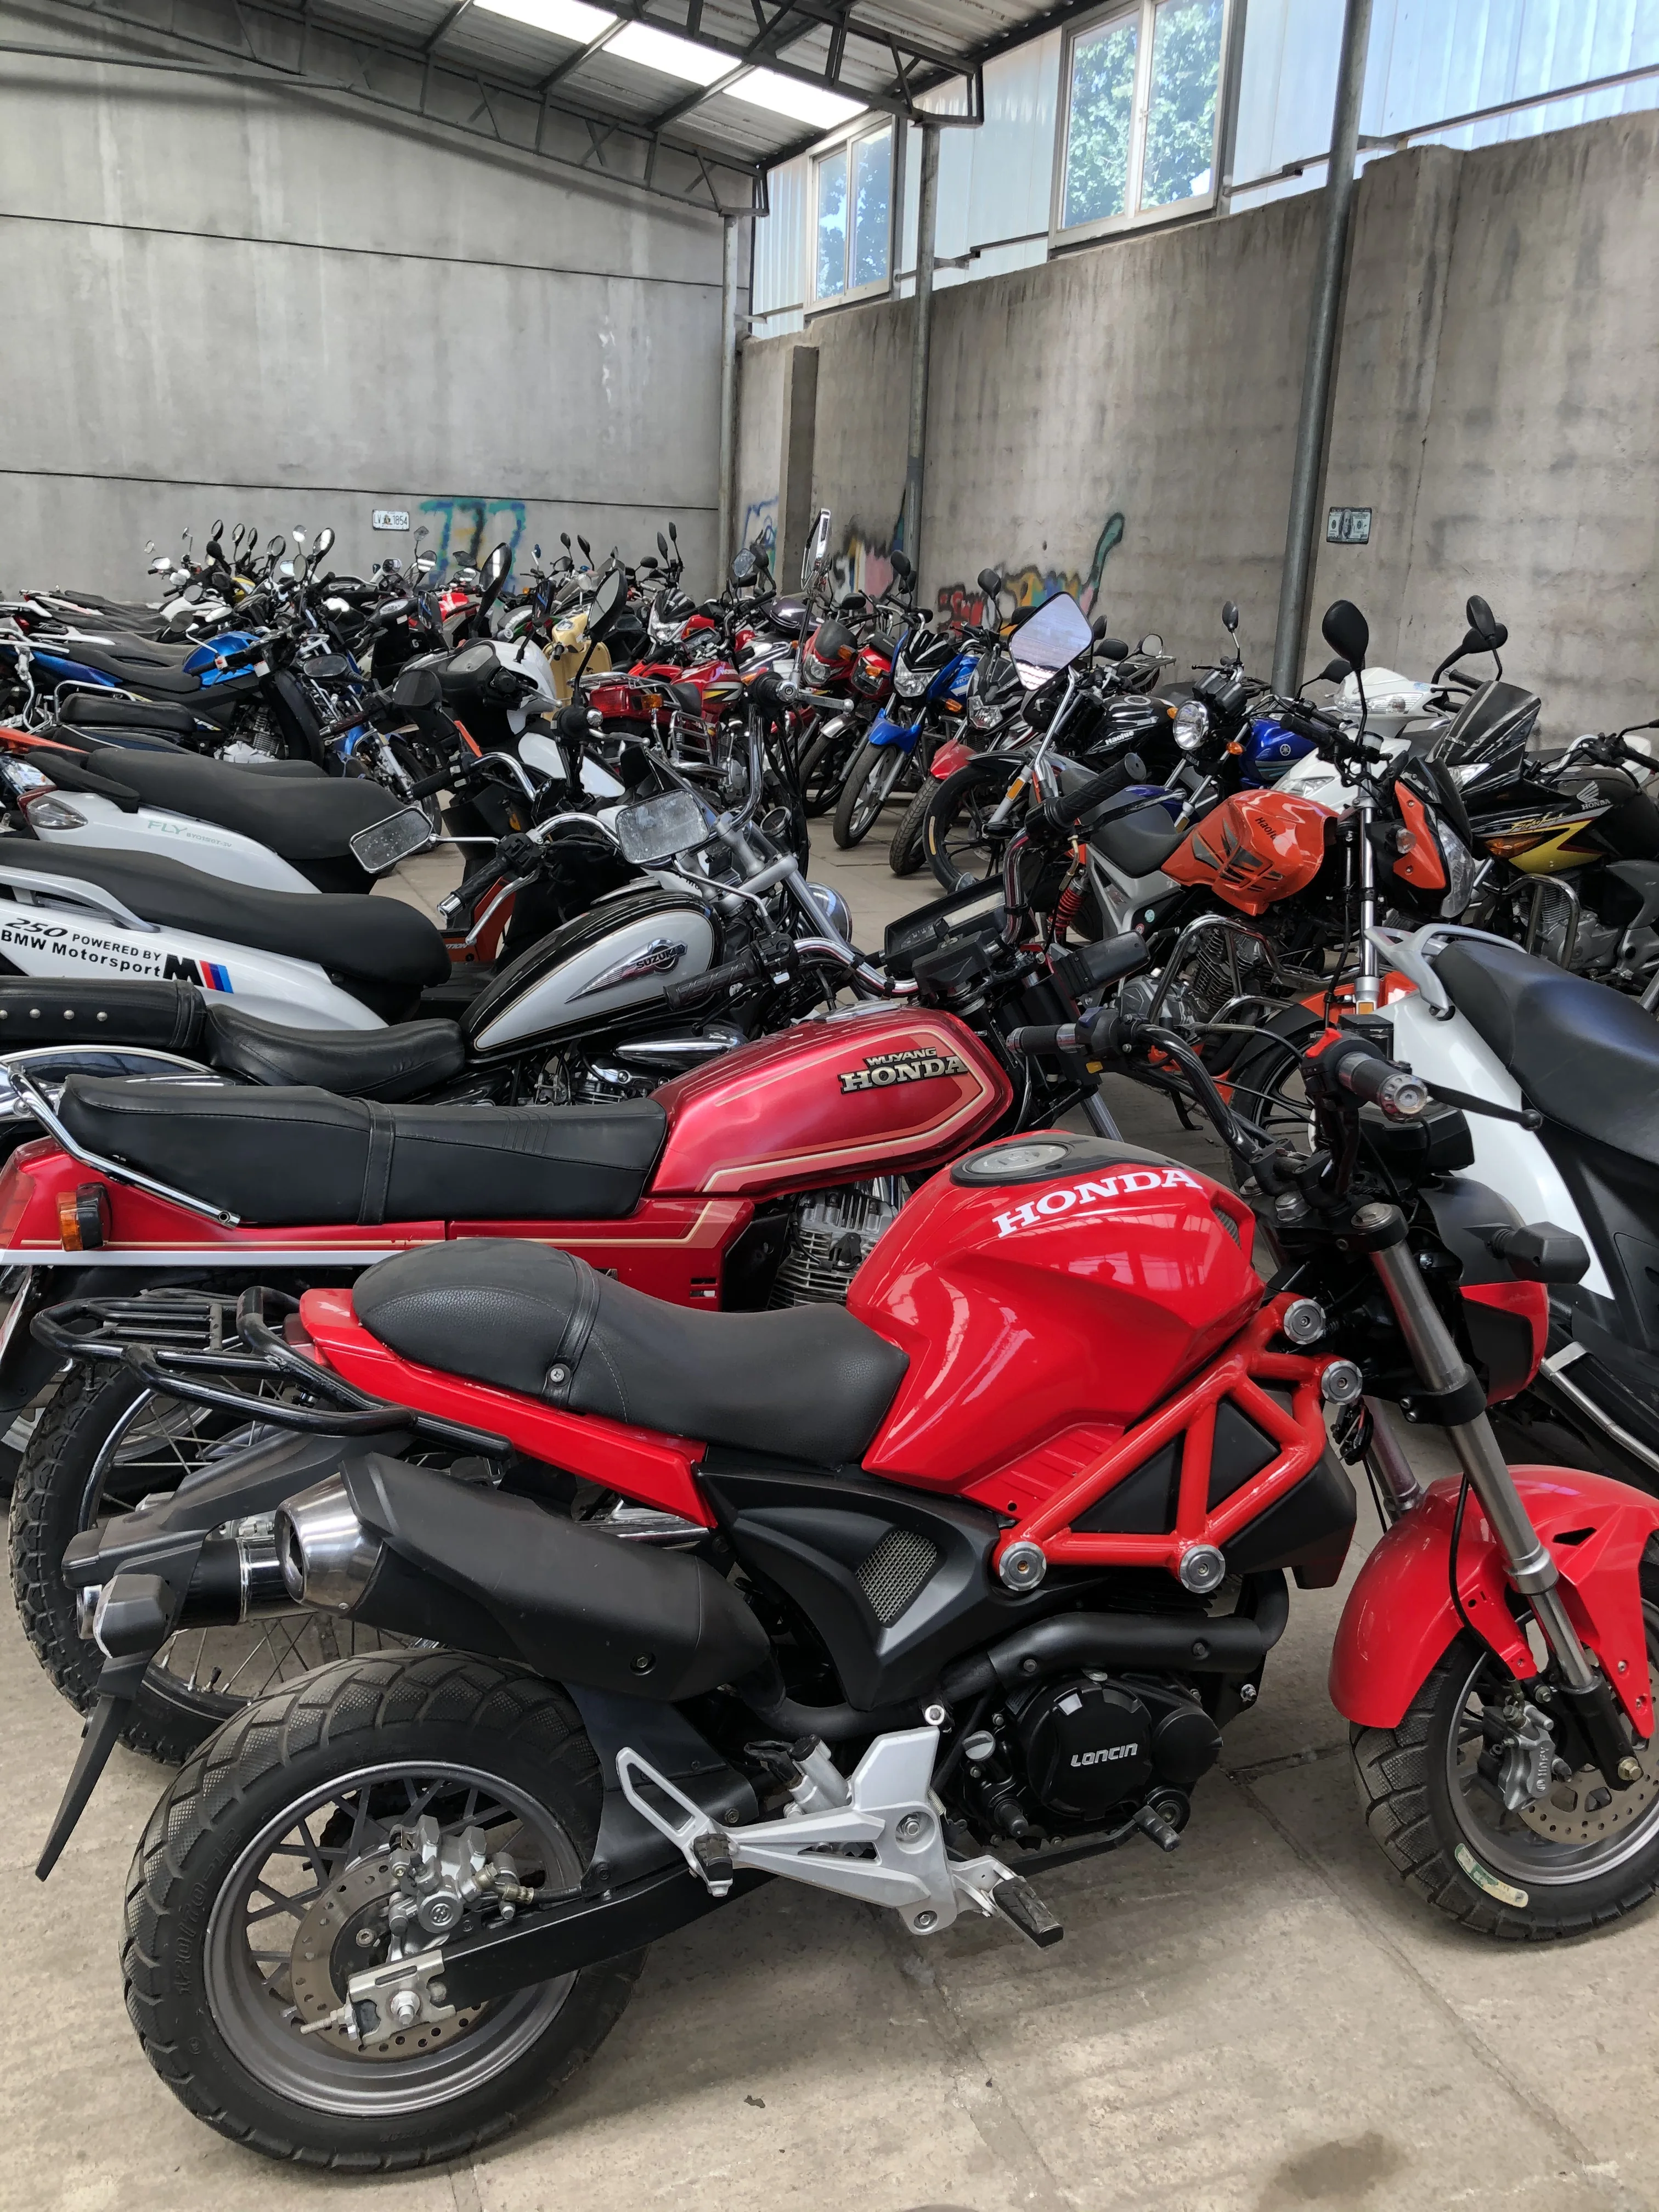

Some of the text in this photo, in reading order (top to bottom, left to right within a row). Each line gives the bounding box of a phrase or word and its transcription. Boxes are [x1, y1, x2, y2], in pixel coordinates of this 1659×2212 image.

[393, 515, 408, 525] 1854
[1105, 731, 1135, 745] Haojue
[1581, 799, 1611, 810] HONDA
[148, 820, 188, 834] FLY
[1255, 817, 1278, 841] Haoju
[5, 918, 162, 961] 250 POWERED BY
[1, 929, 47, 950] BMW
[52, 941, 161, 977] Motorsport
[866, 1047, 936, 1066] WUYANG
[840, 1056, 969, 1092] HONDA
[992, 1169, 1203, 1238] HONDA
[1070, 1742, 1138, 1767] LONCIN
